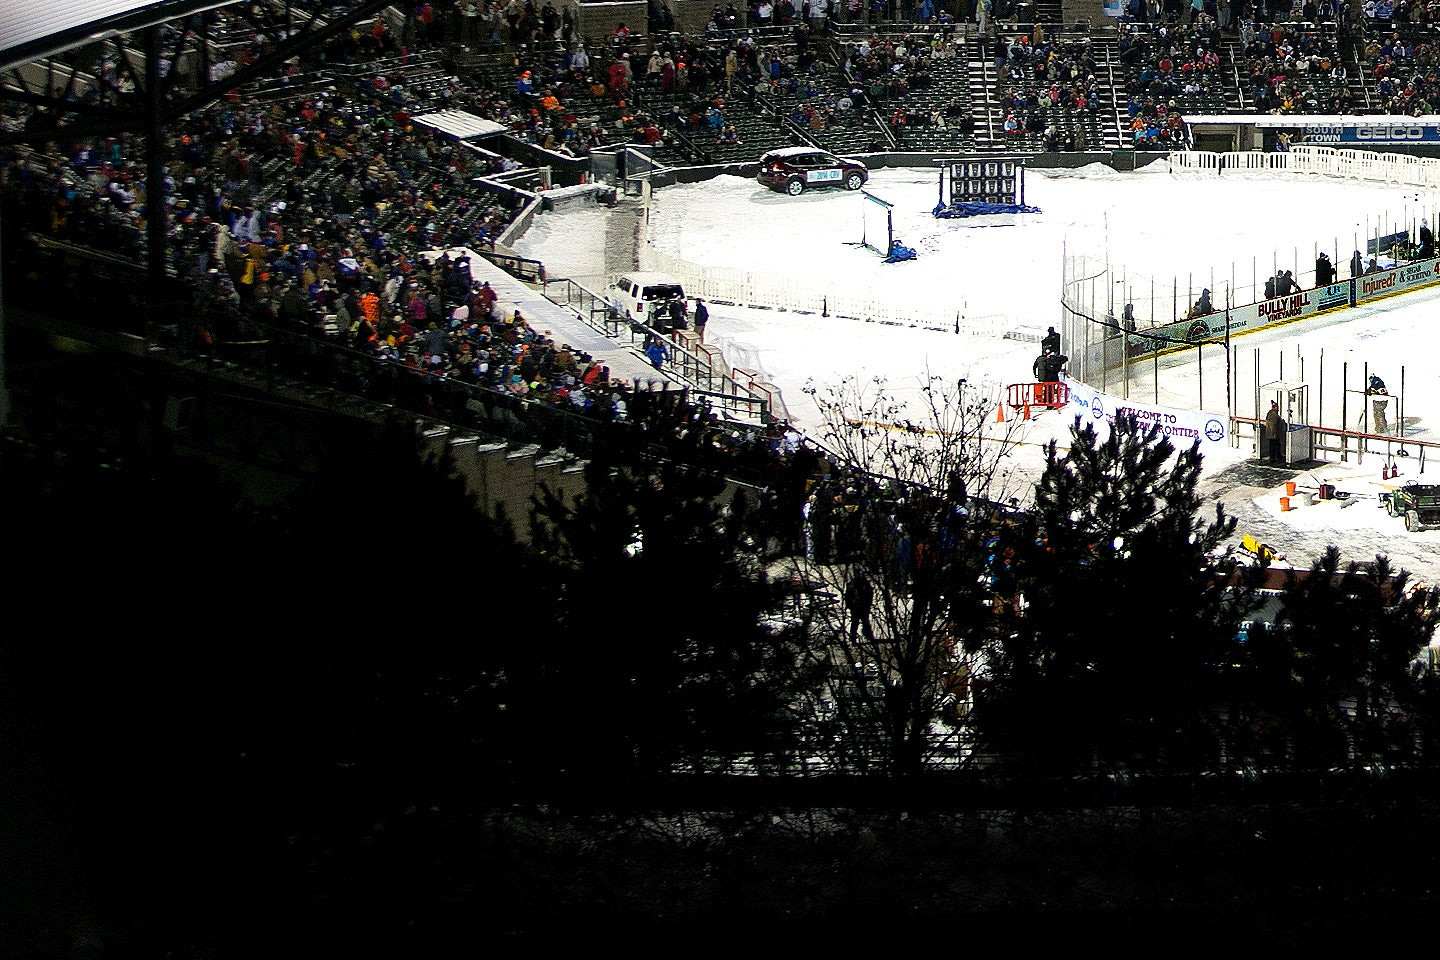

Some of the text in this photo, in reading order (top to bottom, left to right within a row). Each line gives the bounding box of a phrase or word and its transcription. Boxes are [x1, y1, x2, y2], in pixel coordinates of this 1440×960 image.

[1306, 126, 1344, 134] SOUTH
[1356, 126, 1424, 139] GEICO
[1310, 134, 1341, 142] TOWN
[1362, 271, 1397, 294] Injured?
[1257, 295, 1292, 318] BULLY
[1289, 292, 1311, 309] HILL
[1266, 307, 1303, 323] VINEYARDS
[1120, 406, 1177, 424] WELCOME TO
[1156, 424, 1199, 439] RONTIER
